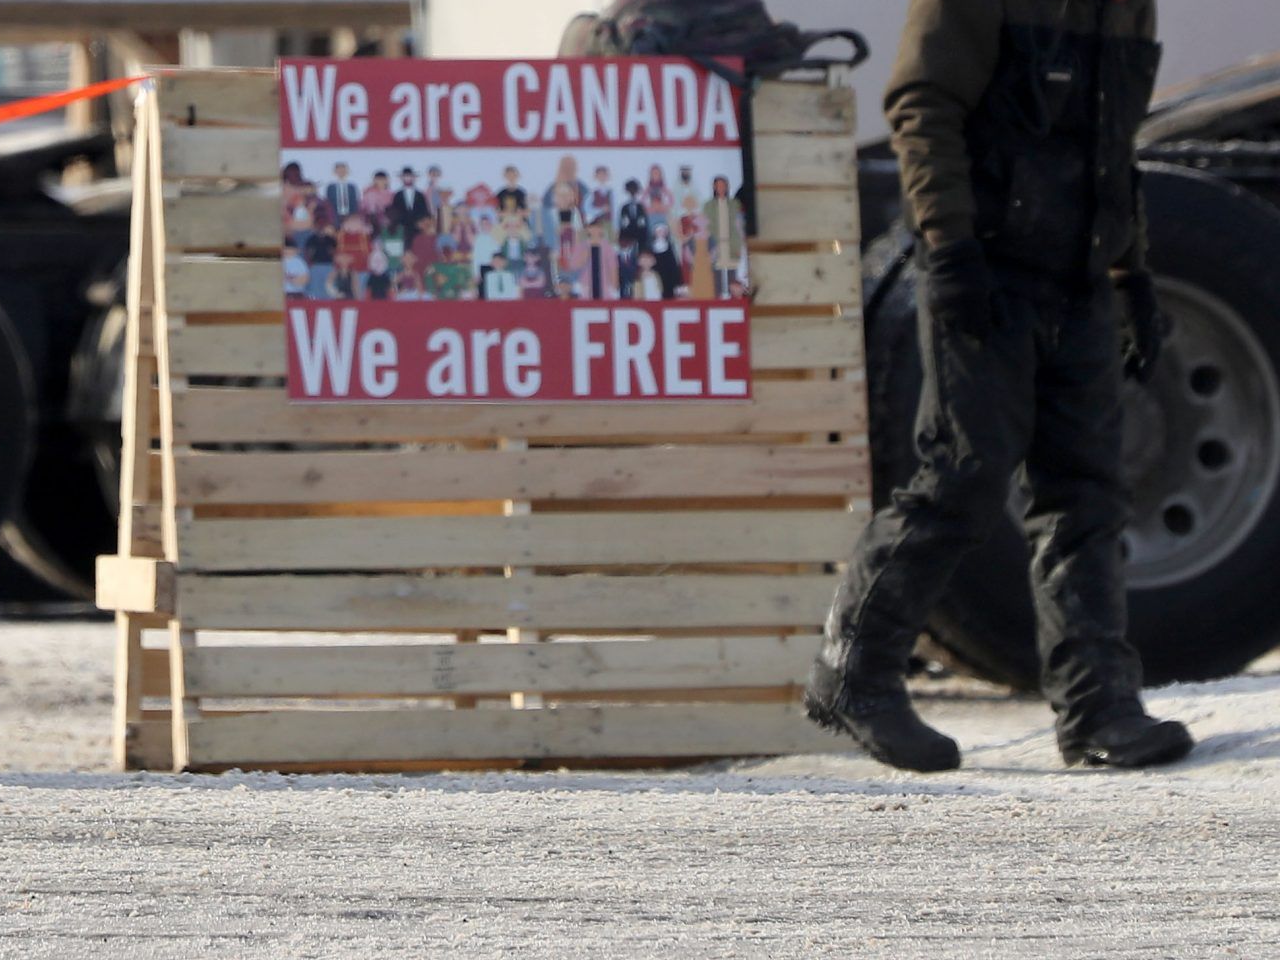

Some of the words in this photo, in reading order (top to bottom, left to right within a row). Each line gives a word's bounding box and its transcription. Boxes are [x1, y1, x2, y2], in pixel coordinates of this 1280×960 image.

[283, 64, 369, 141] We
[389, 81, 482, 141] are
[502, 63, 740, 141] CANADA
[289, 307, 398, 397] We
[425, 327, 542, 397] are
[570, 307, 748, 396] FREE
